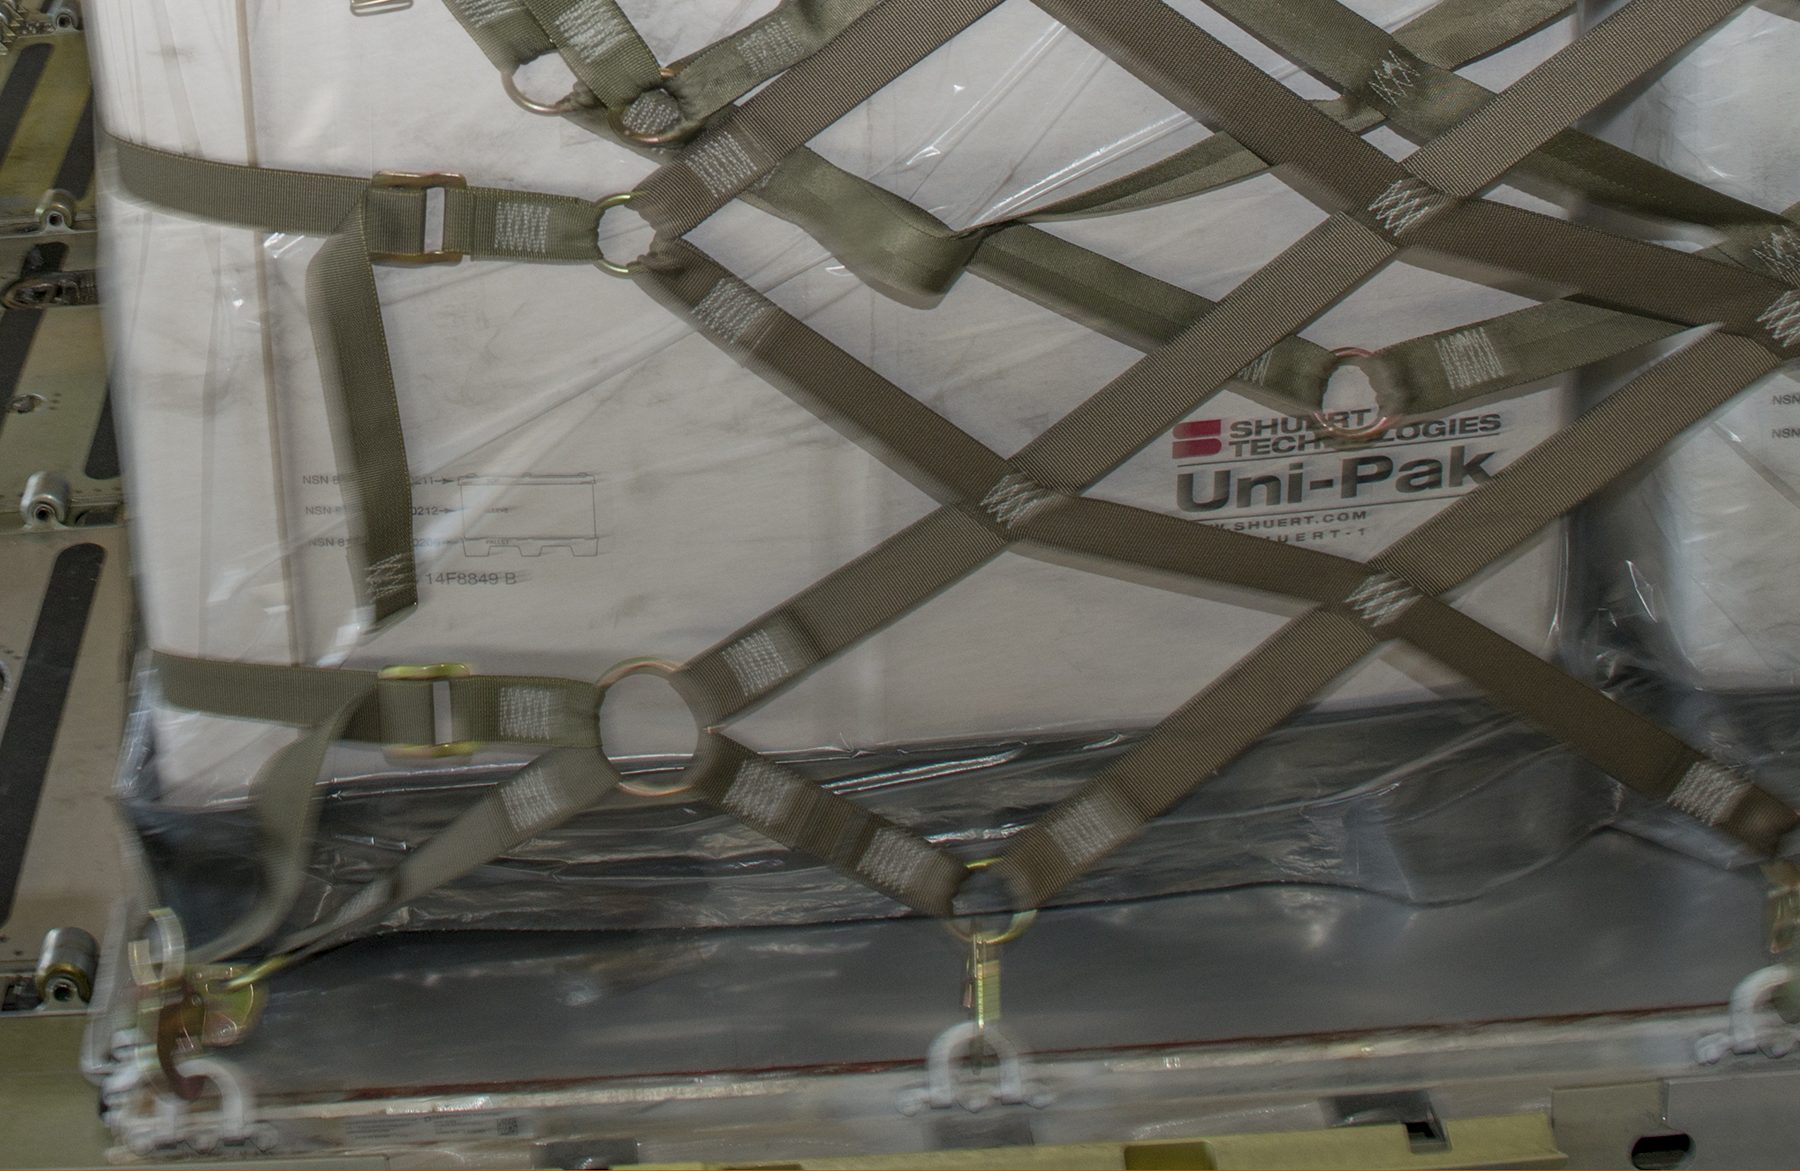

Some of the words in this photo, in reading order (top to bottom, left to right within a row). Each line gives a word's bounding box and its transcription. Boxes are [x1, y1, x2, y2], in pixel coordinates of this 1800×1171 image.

[302, 475, 329, 485] NSN
[1177, 444, 1496, 513] Uni-Pak
[425, 572, 499, 585] 14F8849
[505, 572, 517, 585] B
